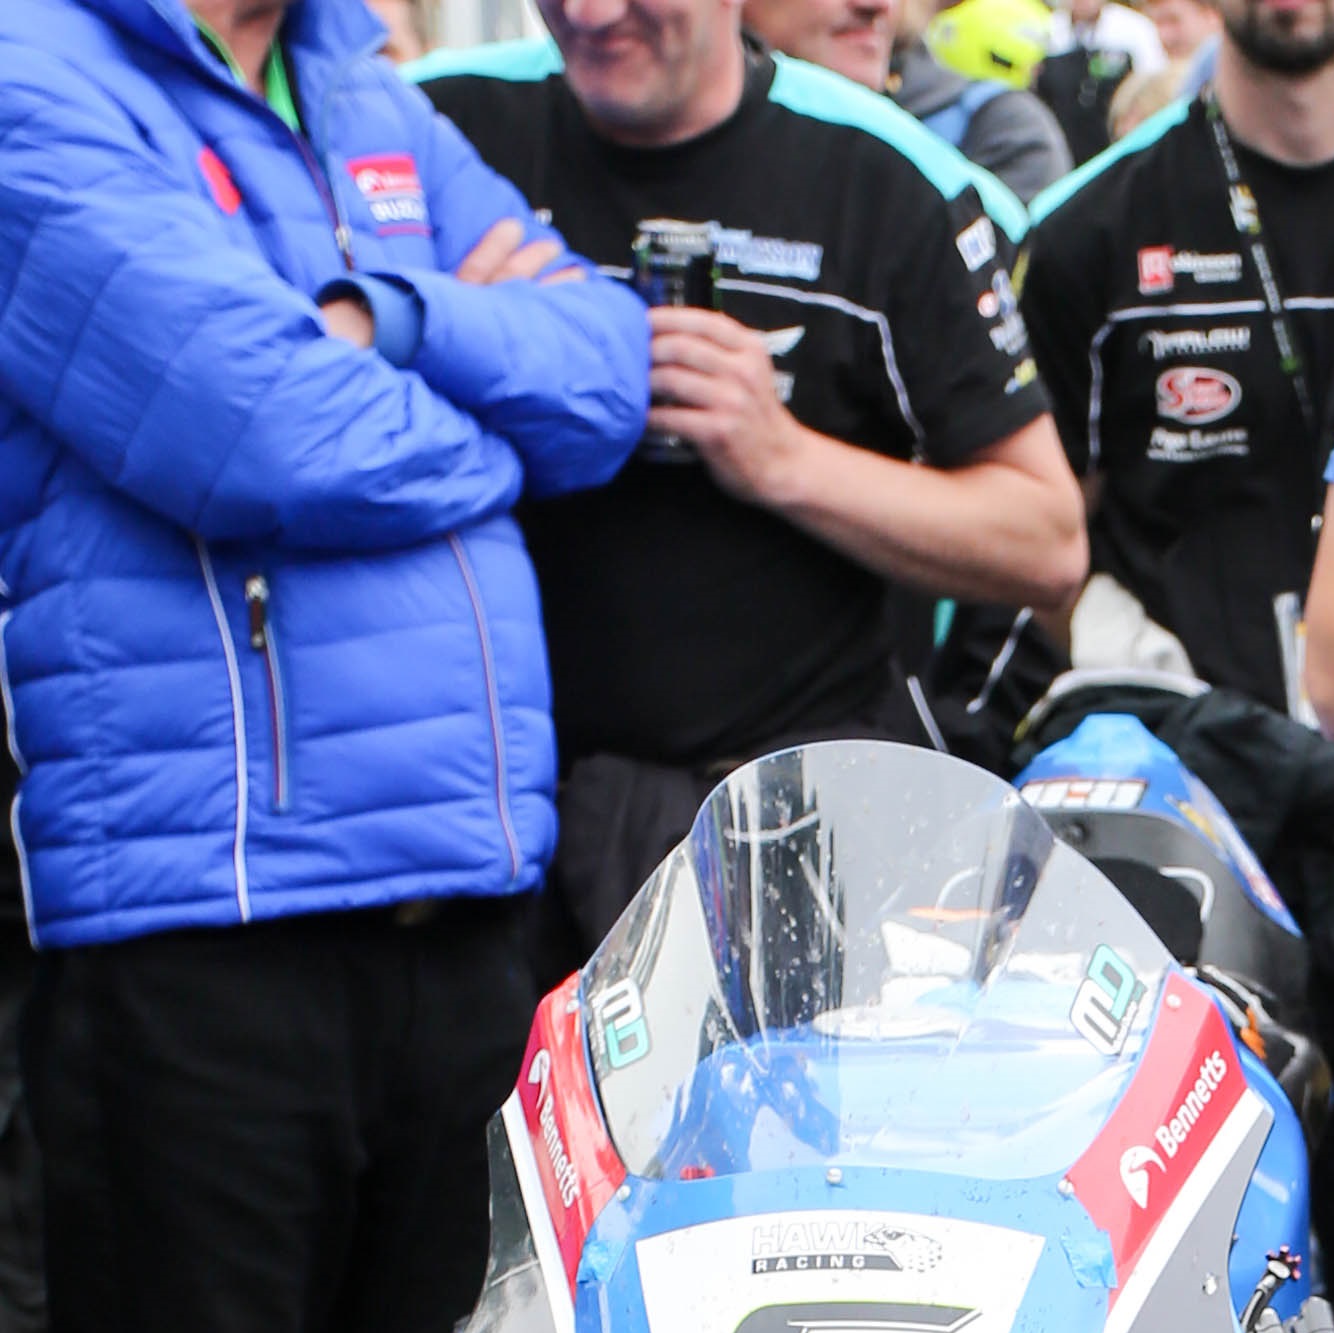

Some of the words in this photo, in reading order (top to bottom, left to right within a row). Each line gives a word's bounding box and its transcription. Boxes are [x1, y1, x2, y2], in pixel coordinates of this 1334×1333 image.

[540, 1095, 581, 1208] Bennetts
[1154, 1050, 1227, 1159] Bennetts
[755, 1255, 866, 1273] RACING
